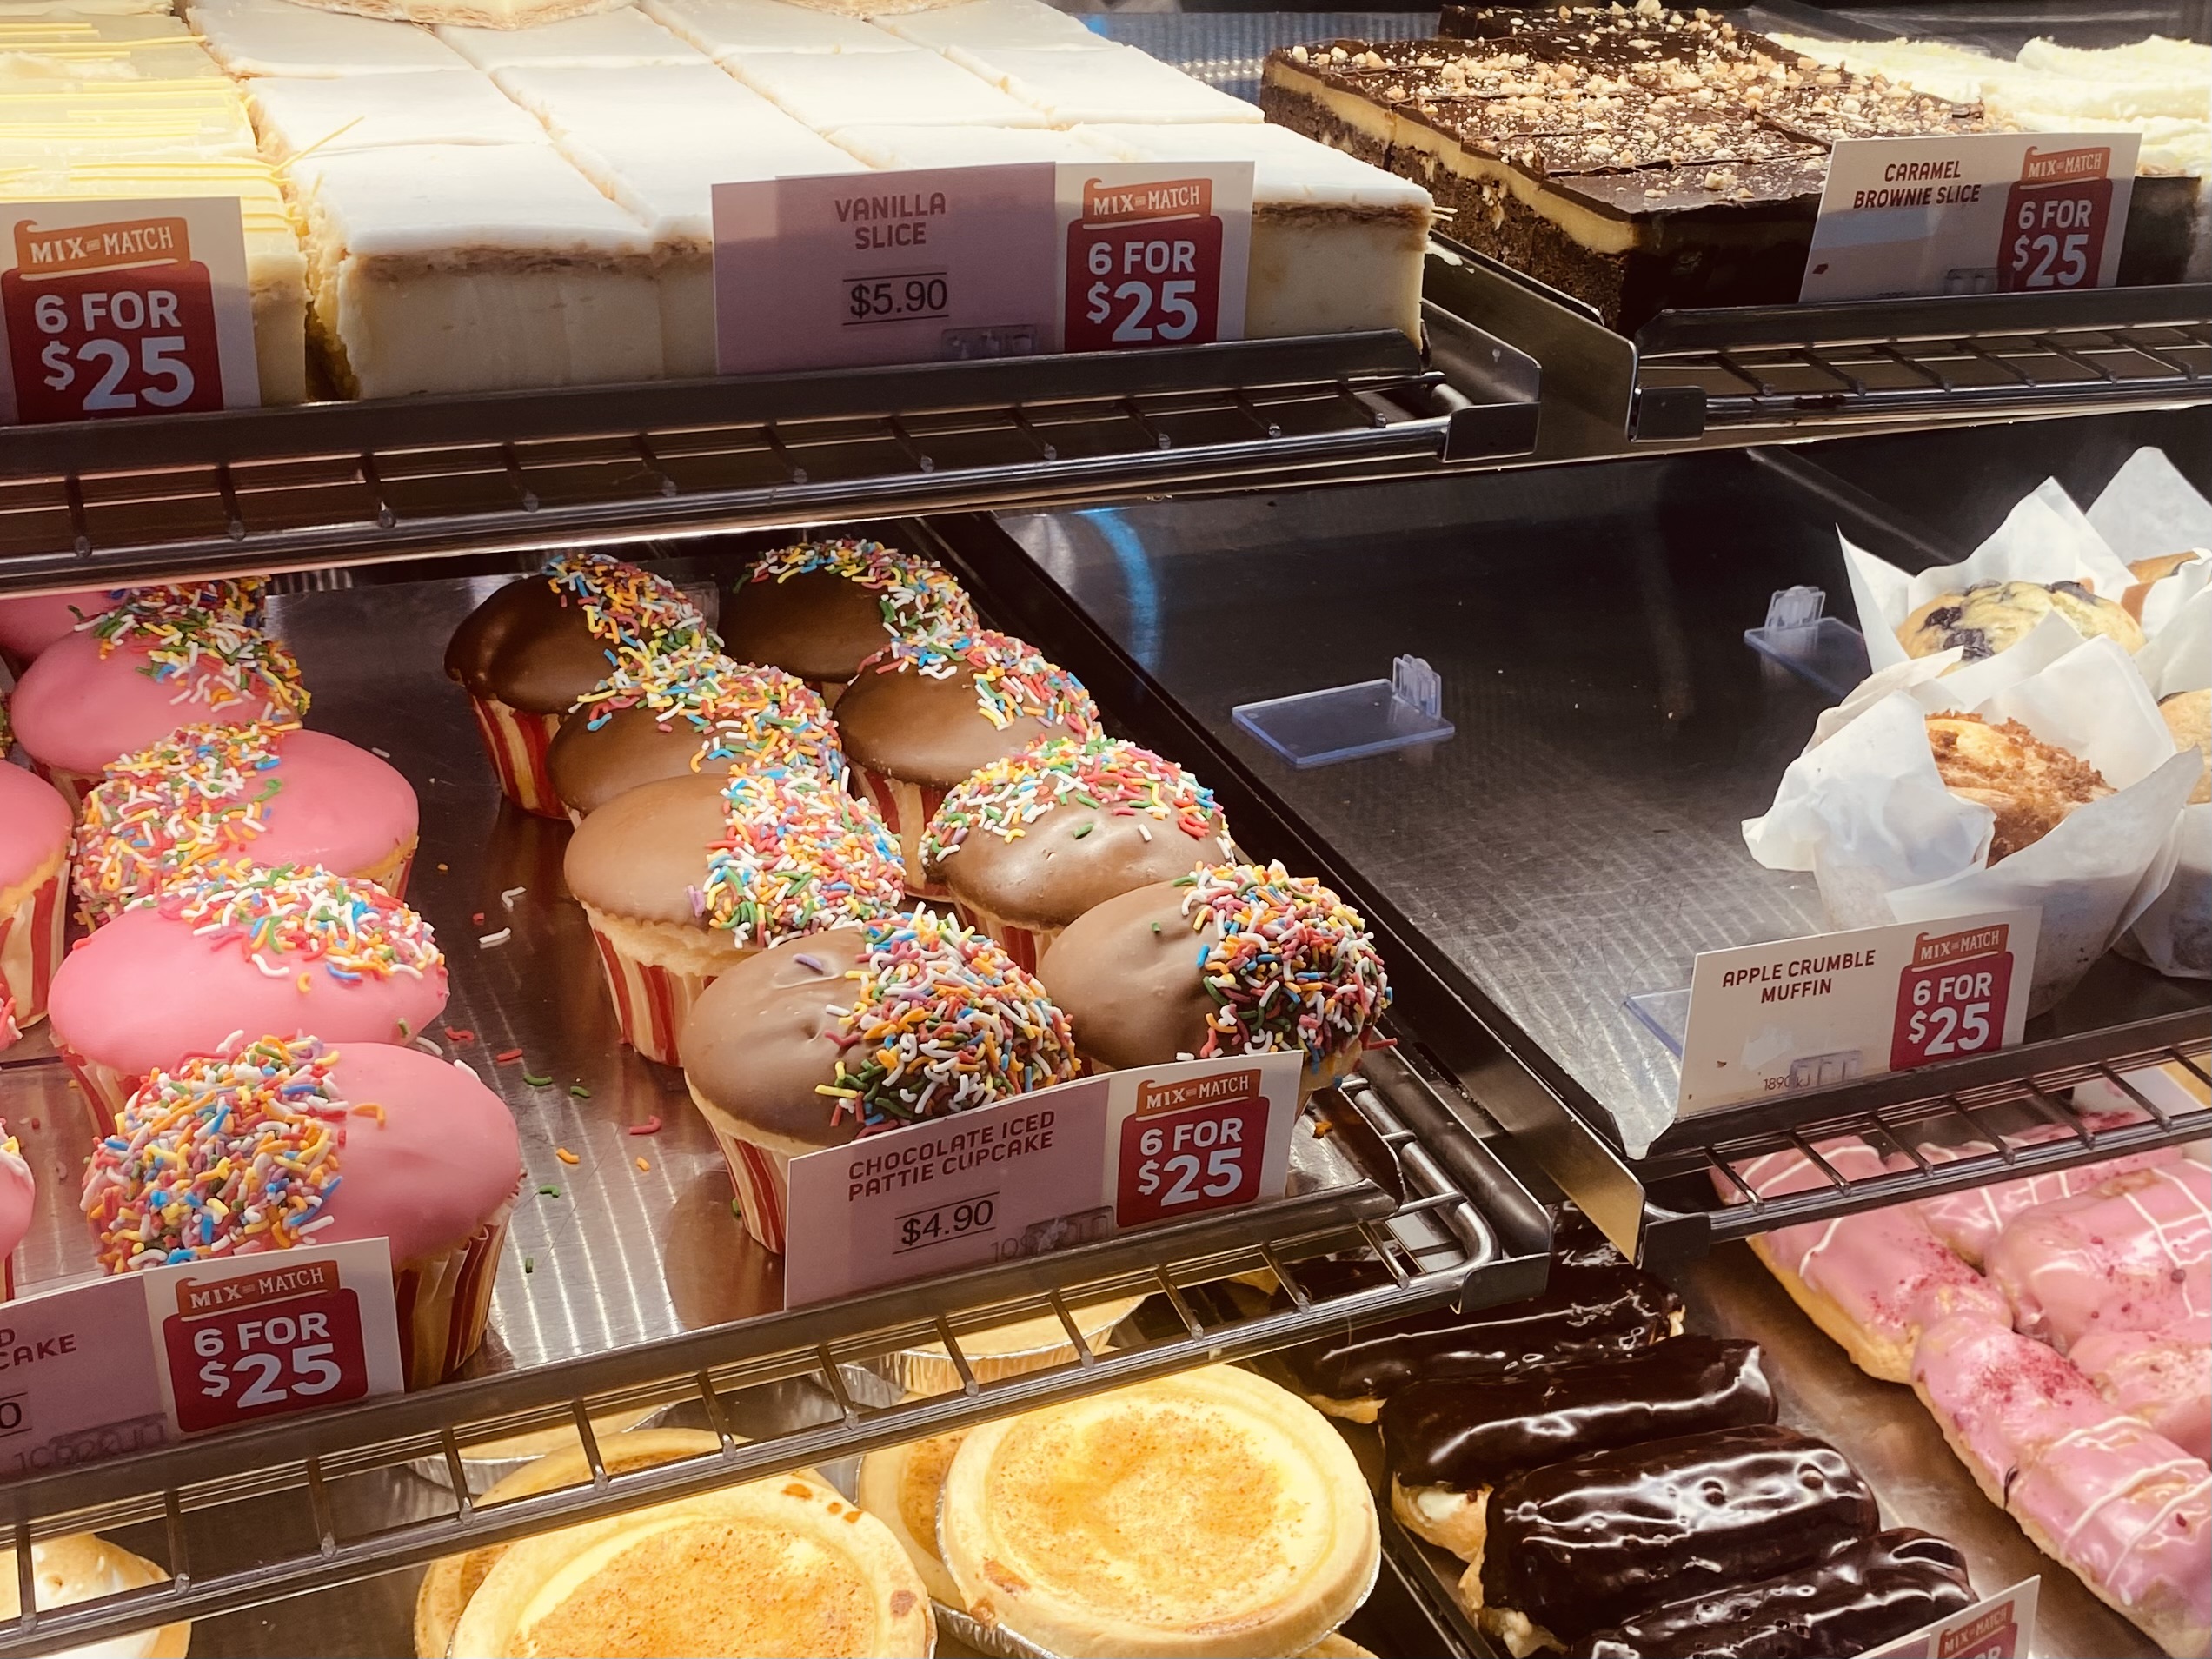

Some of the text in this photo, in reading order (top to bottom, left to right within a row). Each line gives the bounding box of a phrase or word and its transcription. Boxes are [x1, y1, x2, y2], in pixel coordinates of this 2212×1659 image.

[1884, 160, 1962, 182] CARAMEL
[2028, 160, 2057, 178] MIX
[2065, 153, 2102, 173] MATCH
[834, 192, 947, 222] VANILLA
[1093, 193, 1136, 216] MIX
[1147, 185, 1200, 210] MATCH
[1853, 184, 1982, 209] BROWNIE SLICE
[2018, 199, 2093, 229] 6 FOR
[30, 236, 88, 263] MIX
[103, 226, 175, 255] MATCH
[854, 222, 927, 249] SLICE
[1088, 240, 1196, 275] 6 FOR
[2012, 233, 2089, 288] $25
[34, 289, 182, 334] 6 FOR
[849, 278, 948, 320] $5.90
[1086, 279, 1199, 342] $25
[41, 335, 195, 411] $25
[1920, 941, 1950, 961] MIX
[1960, 929, 2000, 952] MATCH
[1722, 949, 1877, 988] APPLE CRUMBLE
[1760, 977, 1833, 1004] MUFFIN
[1912, 972, 1993, 1007] 6 FOR
[1907, 1001, 1990, 1057] $25
[1146, 1074, 1249, 1110] MIX MATCH
[848, 1110, 1055, 1180] CHOCOLATE ICED
[1139, 1118, 1244, 1157] 6 FOR
[848, 1131, 1054, 1202] PATTIE CUPCAKE
[1137, 1147, 1243, 1207] $25
[900, 1199, 994, 1247] $4.90
[189, 1283, 243, 1309] MIX
[258, 1267, 325, 1296] MATCH
[193, 1311, 331, 1357] 6 FOR
[199, 1342, 342, 1409] $25
[1943, 1629, 1970, 1656] MIX
